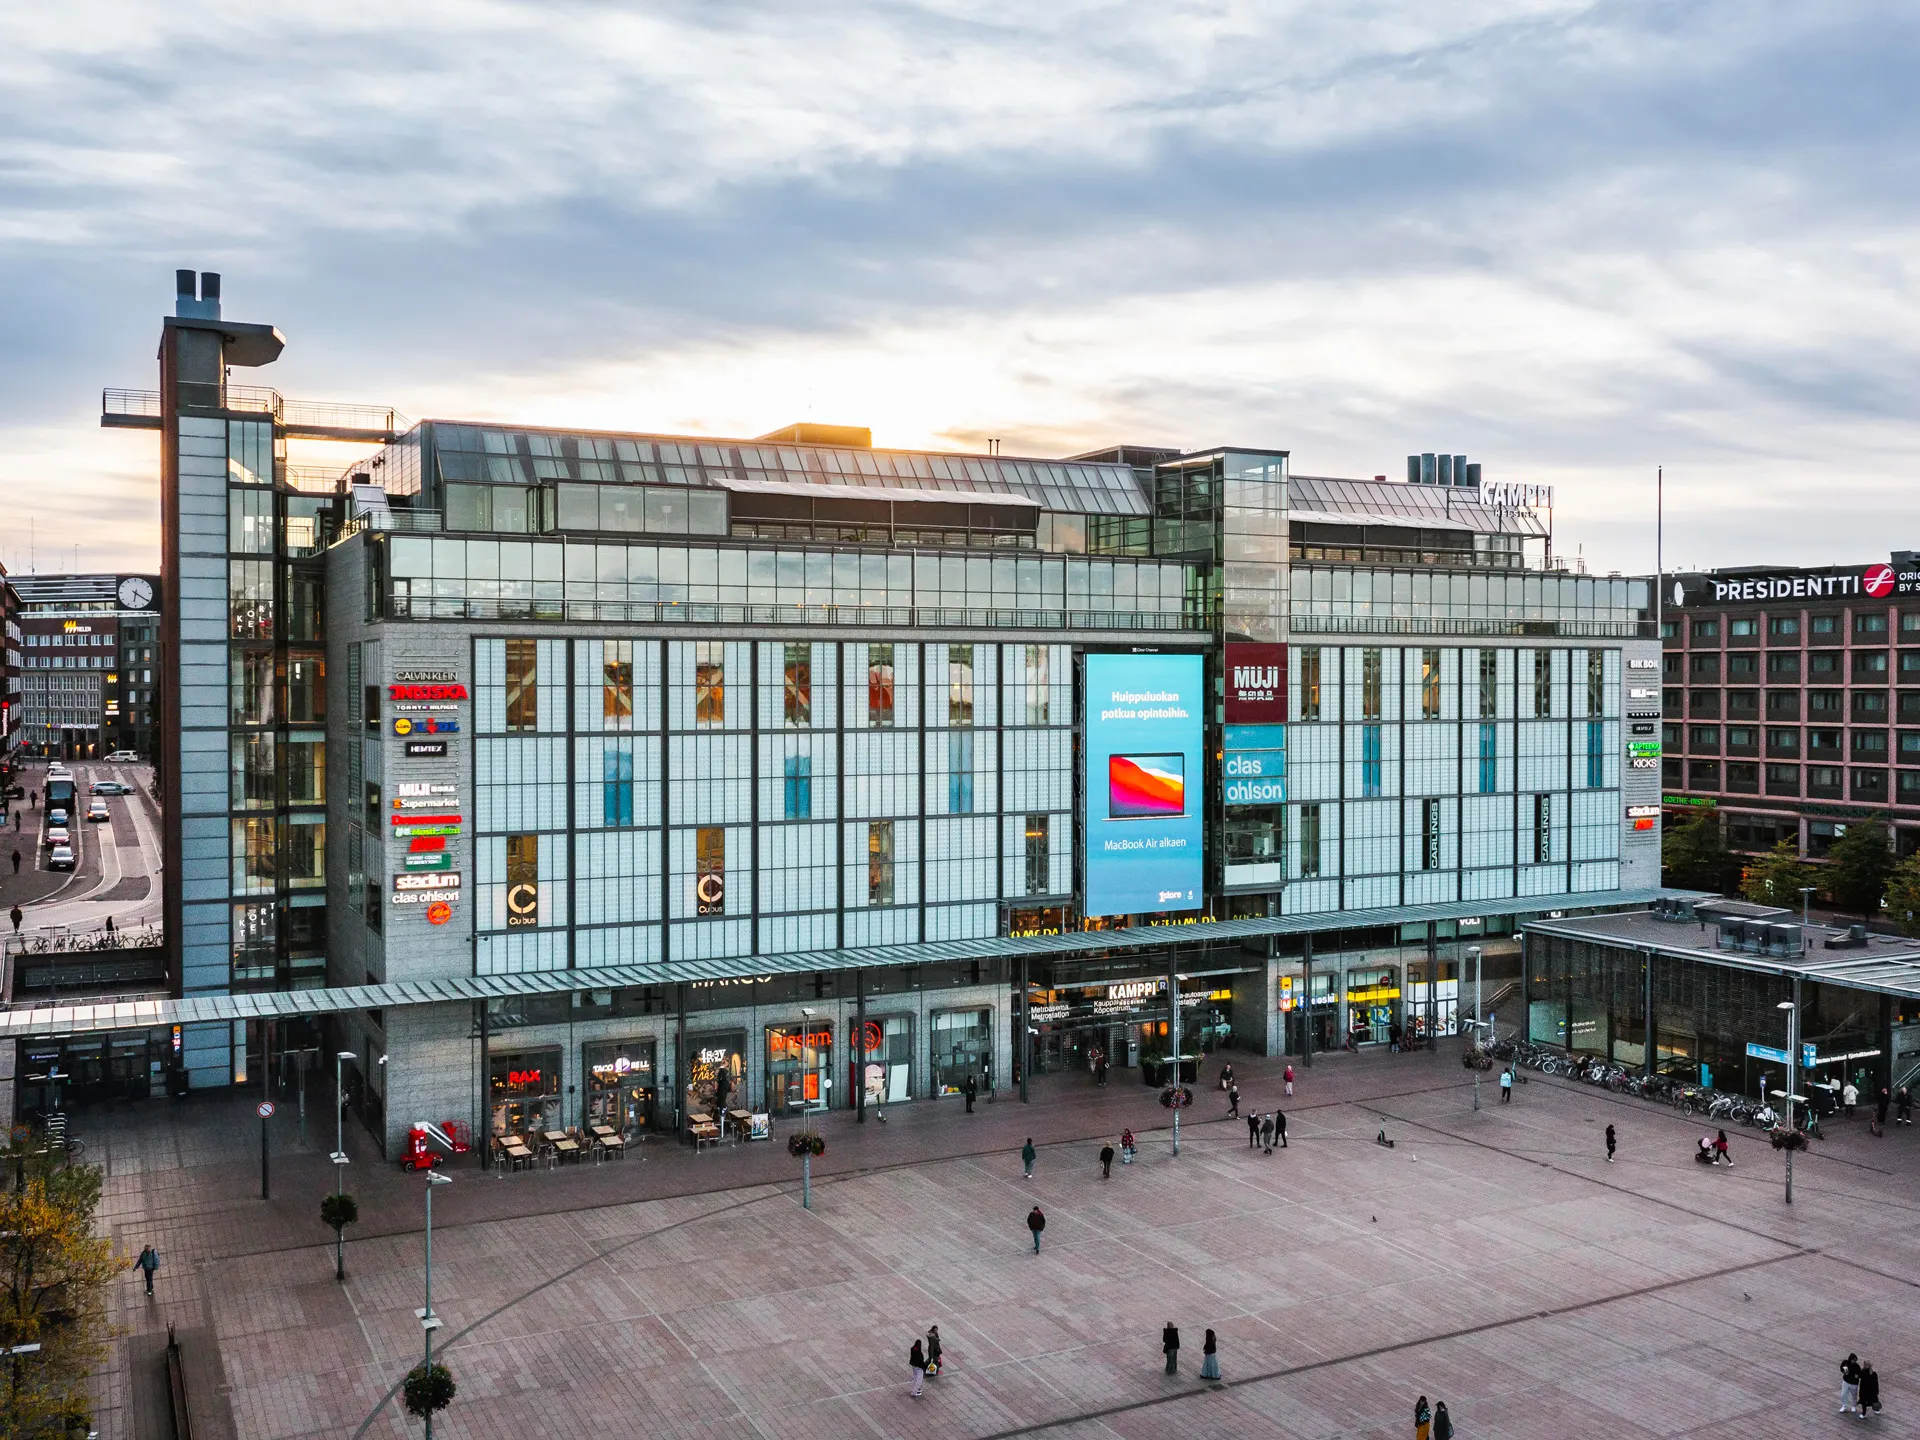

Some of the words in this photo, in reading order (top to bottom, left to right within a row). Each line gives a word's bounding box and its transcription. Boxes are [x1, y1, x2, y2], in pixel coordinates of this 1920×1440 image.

[1480, 481, 1554, 508] KAMPPI
[1716, 576, 1858, 600] PRESIDENTTI
[1899, 583, 1911, 591] BY
[396, 672, 430, 681] CALVIN
[432, 672, 458, 681] KLEIN
[1234, 666, 1278, 689] MUJI
[1112, 691, 1179, 704] Huippuluokan
[1102, 708, 1136, 721] potkua
[1138, 707, 1189, 720] opintoihin.
[1227, 756, 1262, 774] clas
[1633, 759, 1657, 768] KICKS
[1227, 781, 1282, 800] ohlson
[401, 798, 459, 809] Supermarket
[1431, 801, 1439, 869] CARLINGS
[1104, 839, 1143, 850] MacBook
[1146, 838, 1158, 848] Air
[1159, 837, 1186, 847] alkaen
[397, 875, 459, 889] stadium
[392, 893, 417, 903] clas
[419, 891, 459, 902] ohlson
[1109, 981, 1156, 1000] KAMPPI
[509, 1069, 540, 1082] RAX
[593, 1065, 613, 1077] TACO
[631, 1060, 649, 1069] BELL
